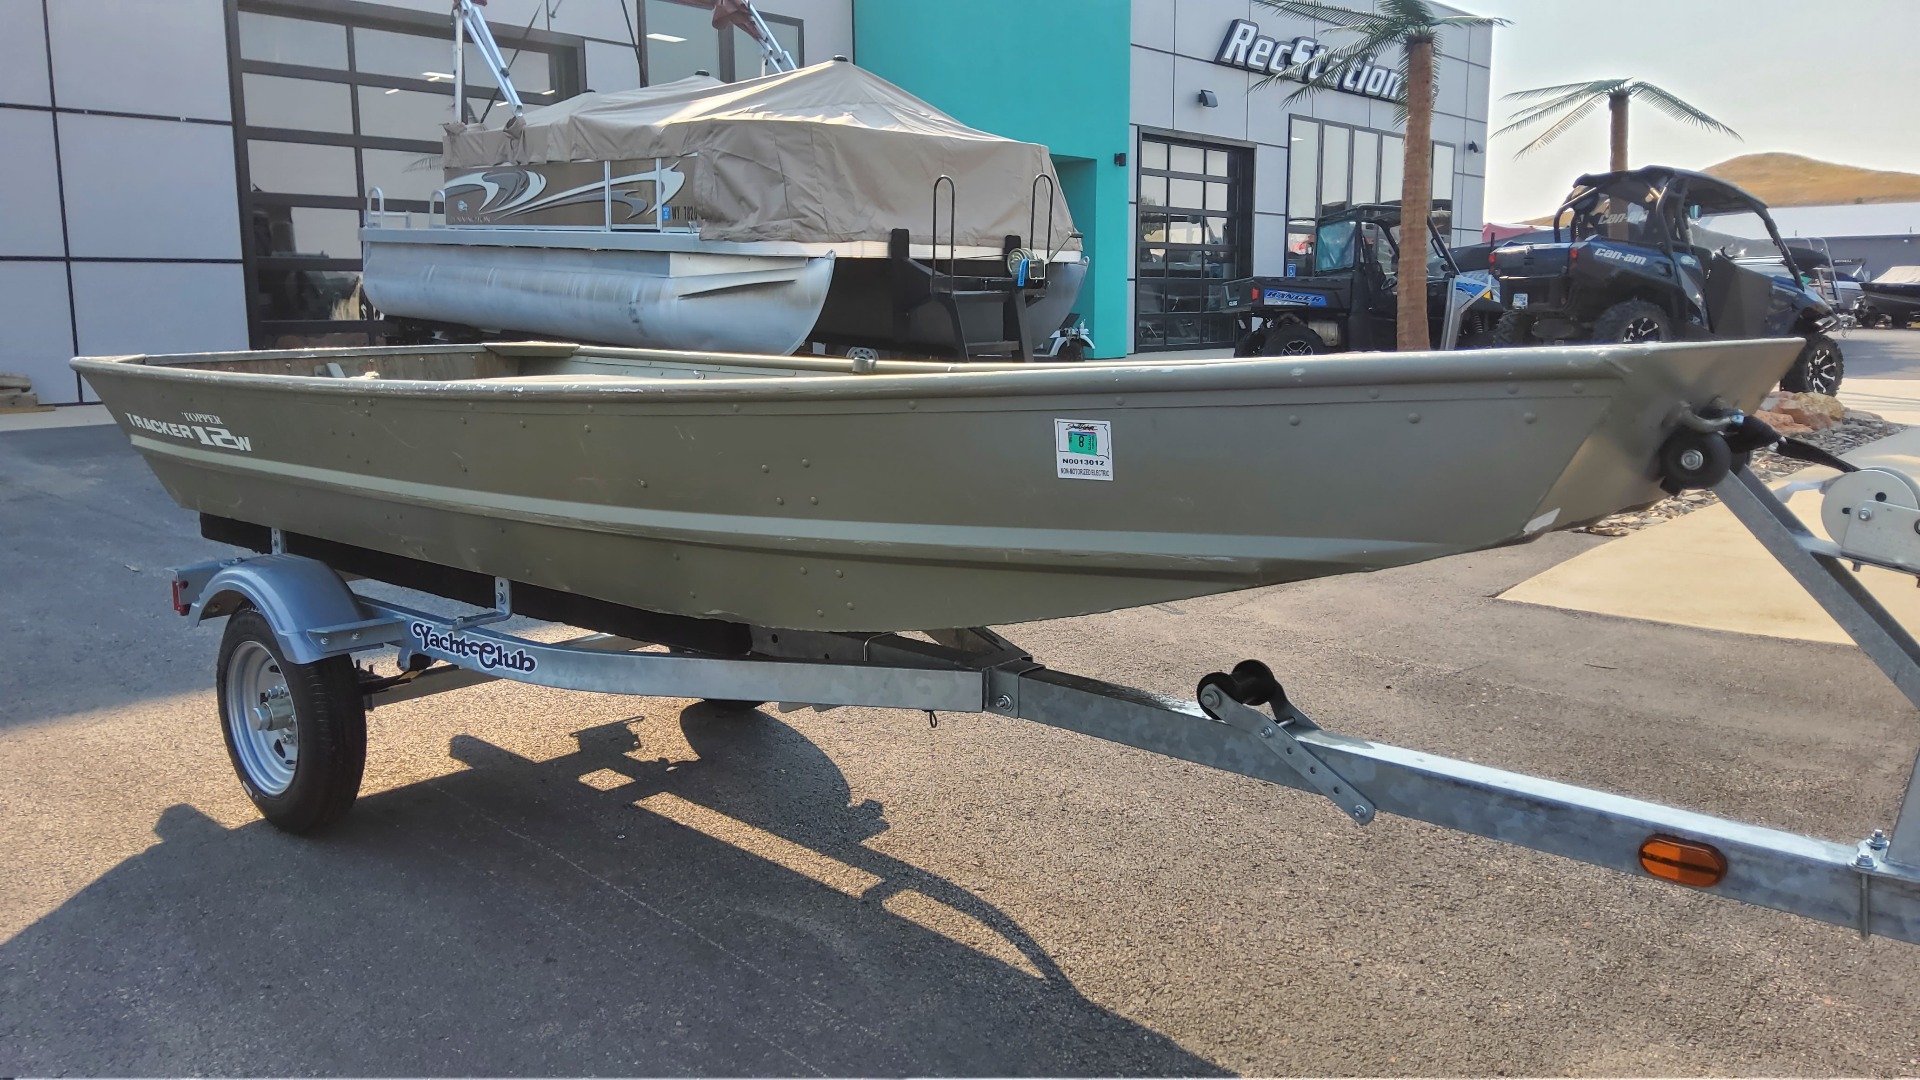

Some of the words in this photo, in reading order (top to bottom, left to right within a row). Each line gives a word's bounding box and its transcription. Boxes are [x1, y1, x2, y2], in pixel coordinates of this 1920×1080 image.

[1595, 248, 1647, 265] can-am
[1266, 291, 1322, 303] RANGER
[181, 412, 223, 425] TOPPER
[125, 413, 194, 439] TRACKER
[1062, 458, 1105, 466] N0013012
